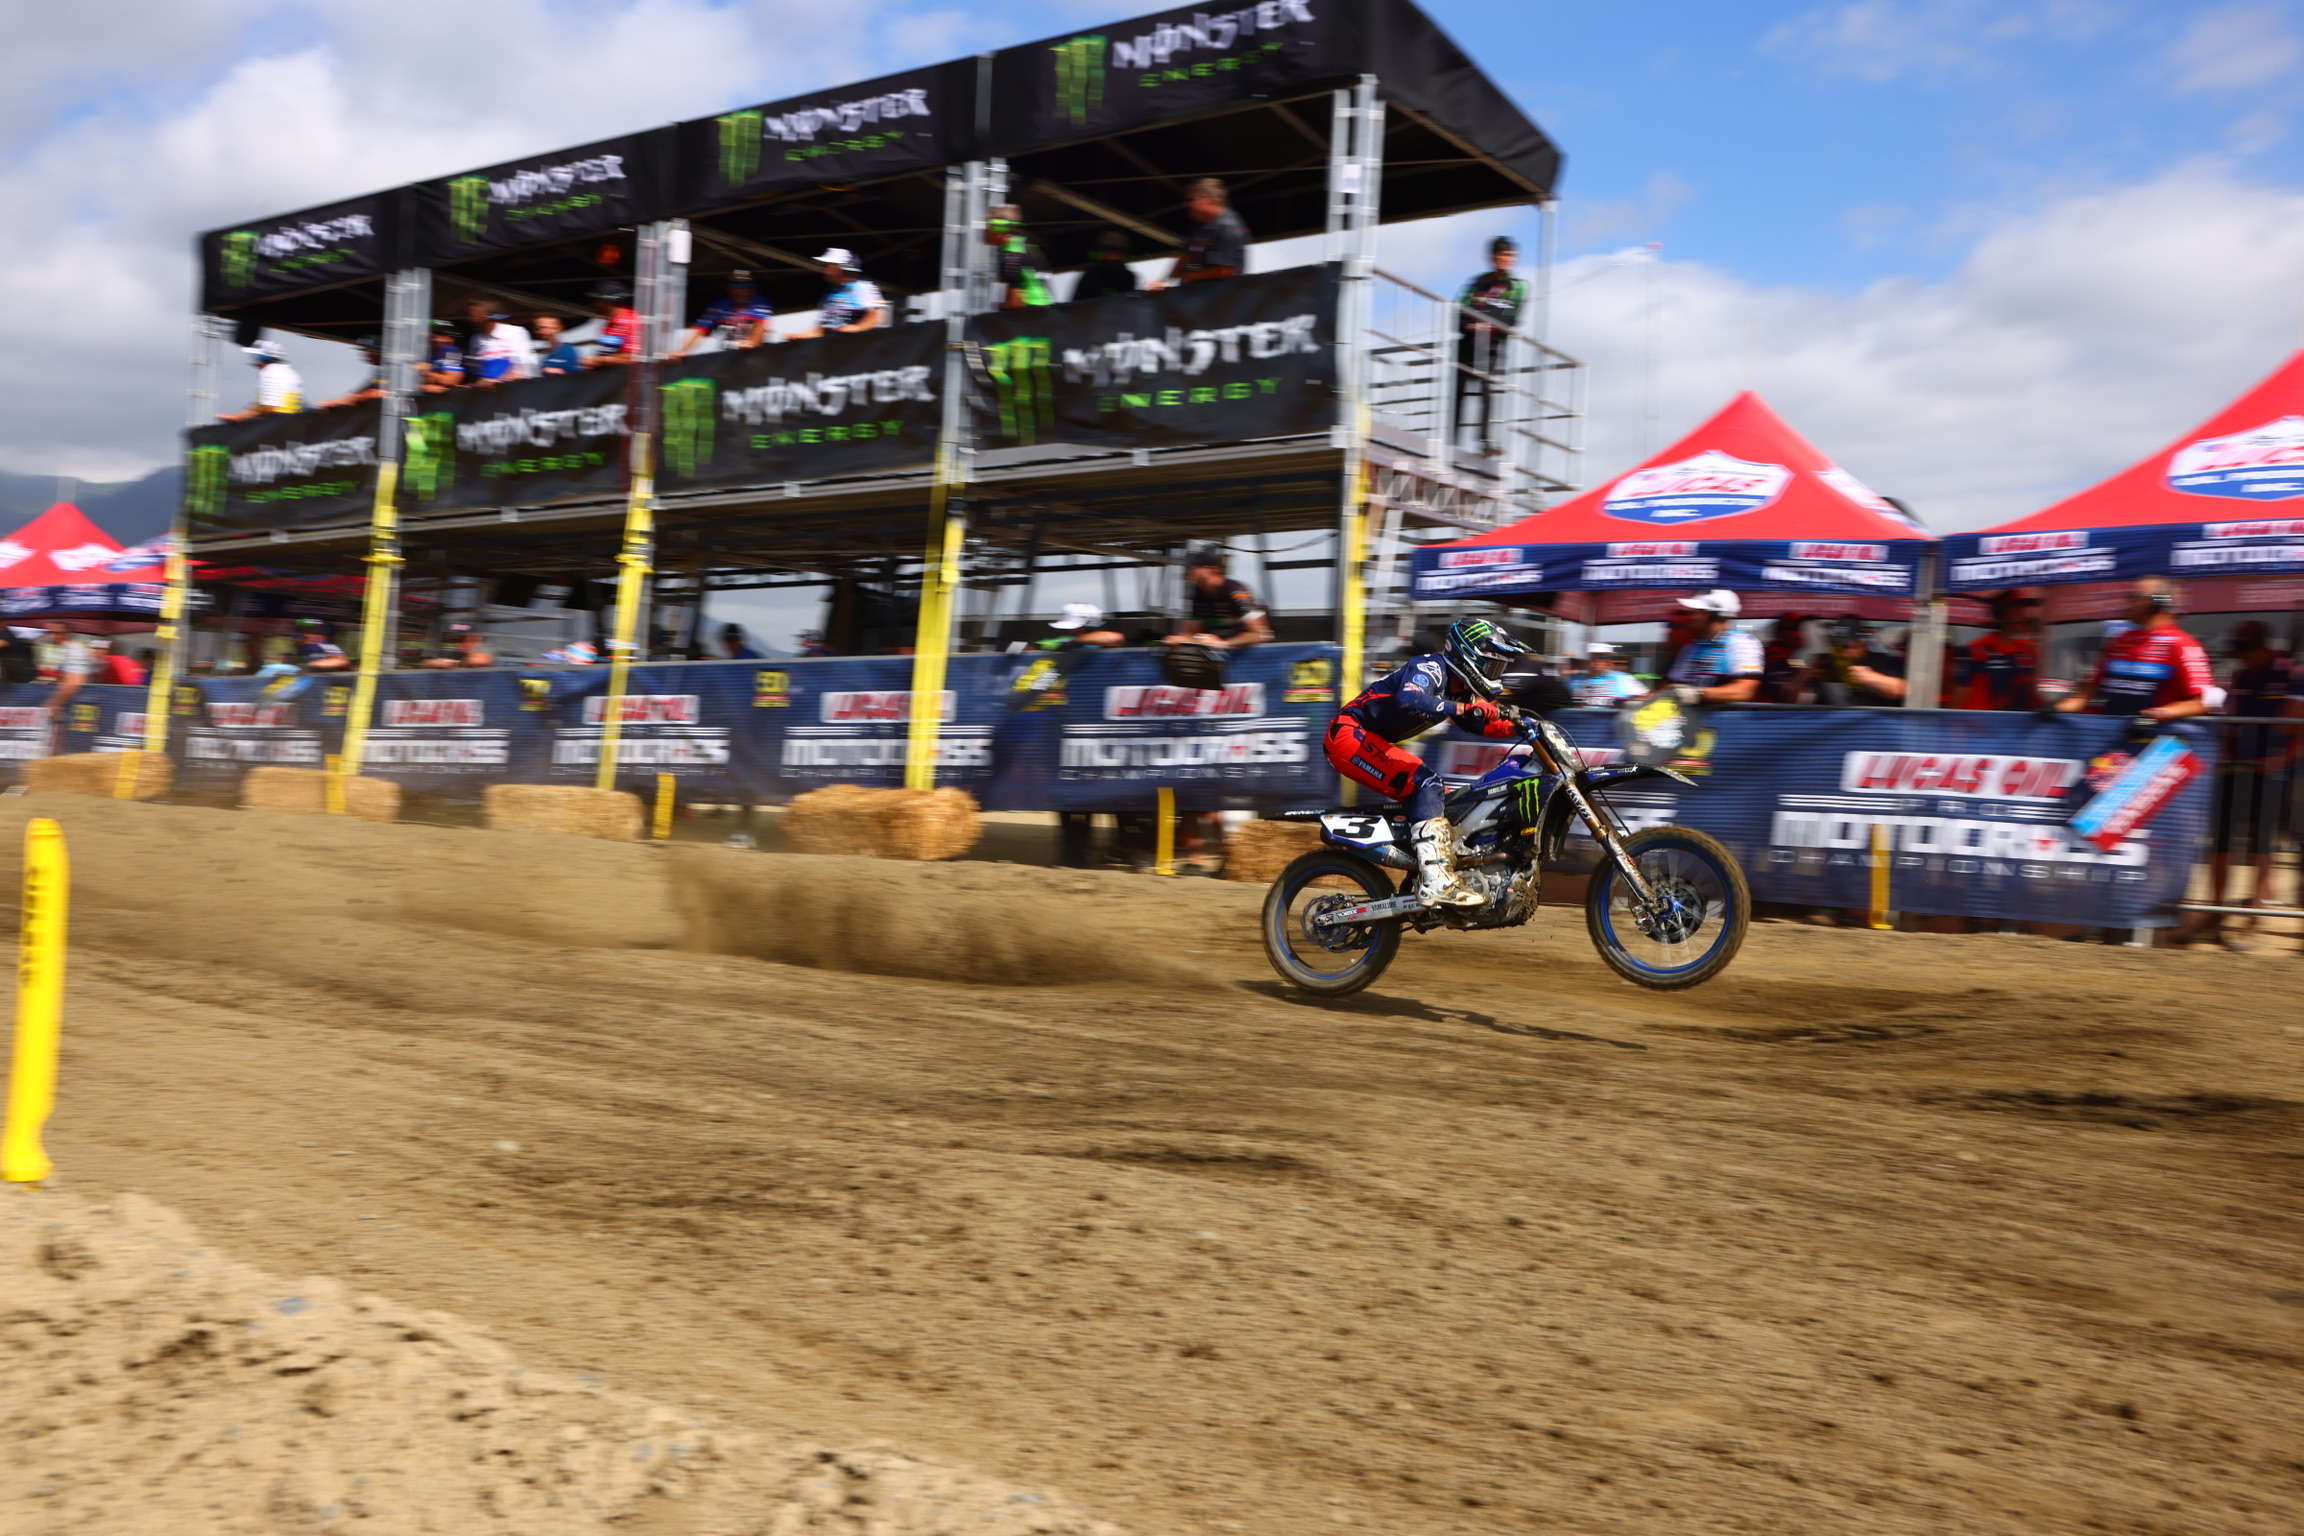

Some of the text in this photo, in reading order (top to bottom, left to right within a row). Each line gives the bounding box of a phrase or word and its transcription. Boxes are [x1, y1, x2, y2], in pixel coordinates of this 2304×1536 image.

[1112, 0, 1315, 68] MONSTER
[1062, 314, 1321, 387] MONSTER
[722, 366, 936, 425] MONSTER
[1097, 377, 1284, 412] ENERGY
[1060, 731, 1310, 766] MOTOCROSS
[1859, 754, 2072, 798] LUCAS OIL
[1565, 787, 1590, 819] KYB
[1332, 815, 1382, 838] 3
